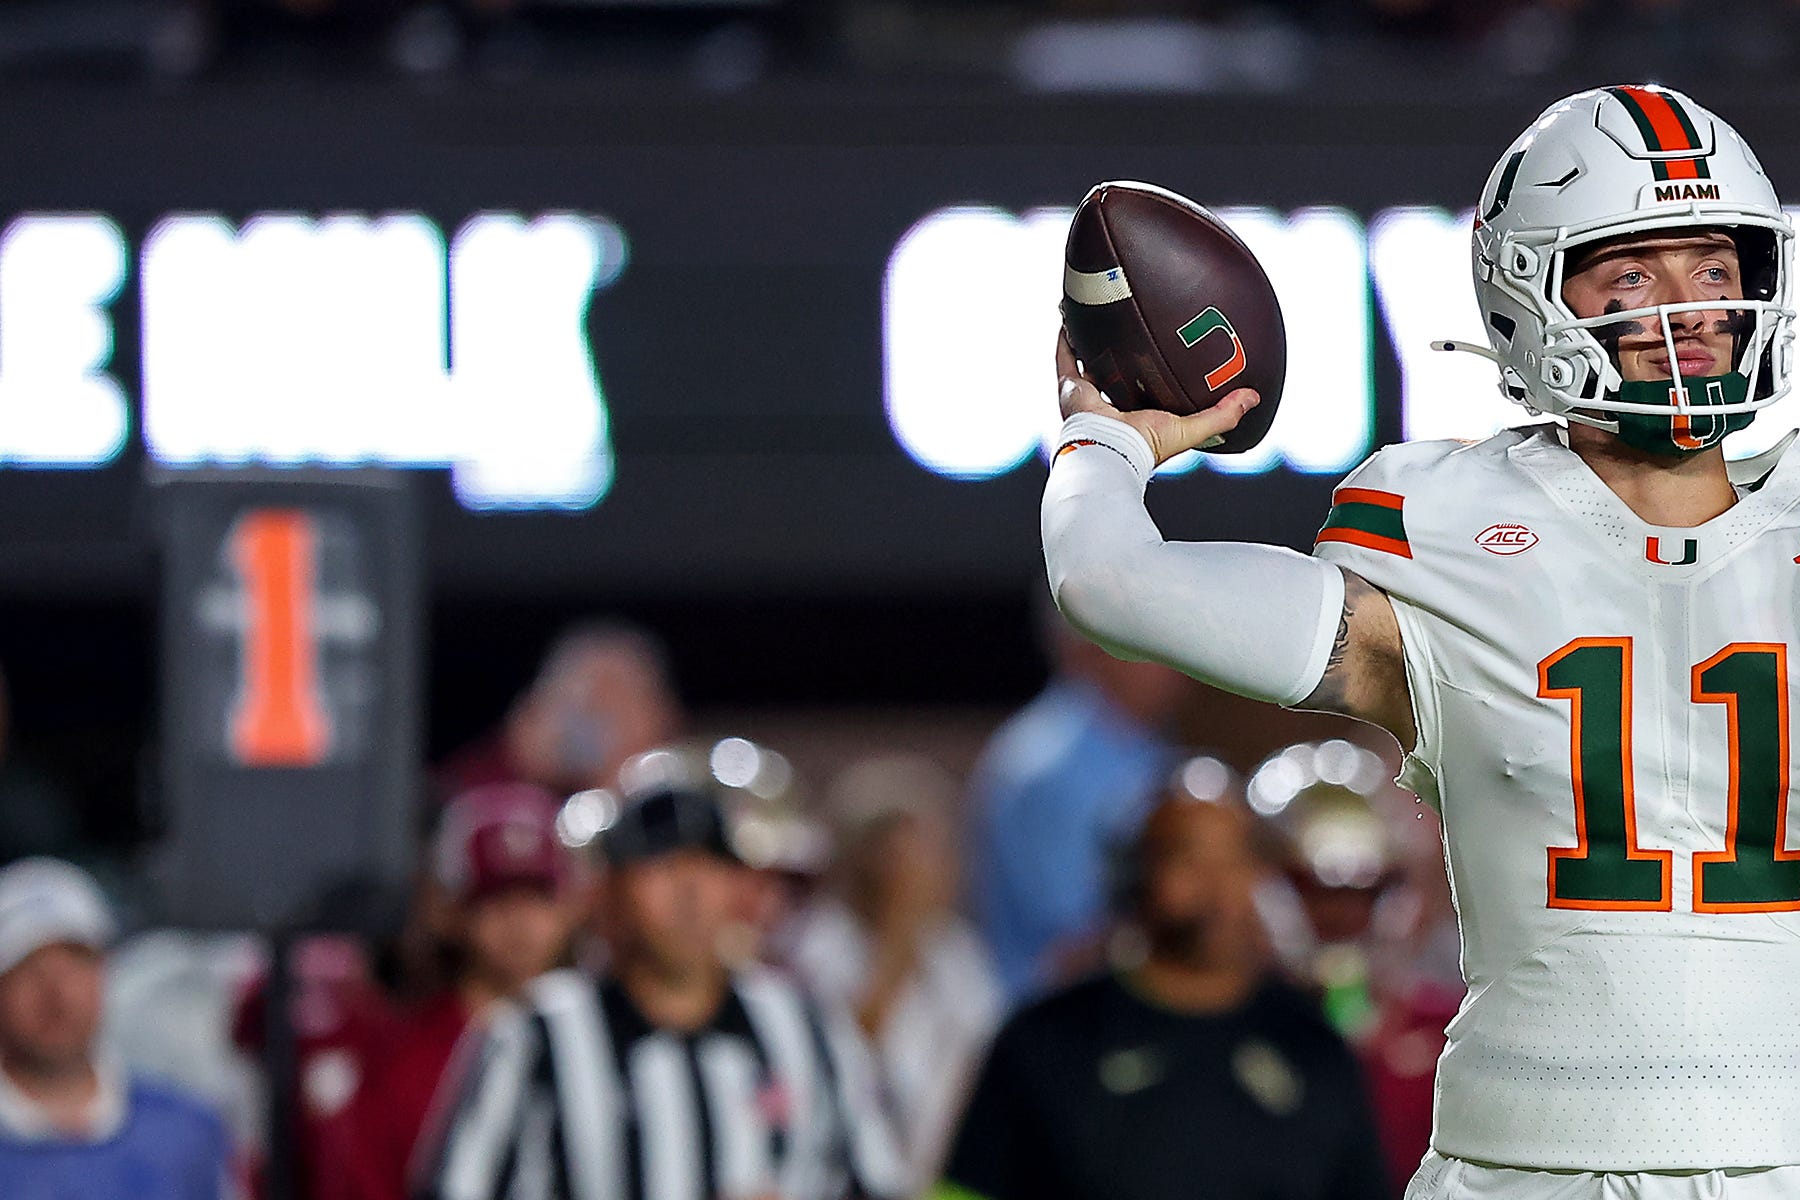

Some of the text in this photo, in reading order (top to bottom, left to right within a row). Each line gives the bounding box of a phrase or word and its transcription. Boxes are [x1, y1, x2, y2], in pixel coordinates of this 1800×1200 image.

[1654, 184, 1720, 202] MIAMI
[1668, 381, 1727, 450] U
[1484, 531, 1530, 543] ACC
[1645, 535, 1698, 566] U
[228, 508, 330, 768] 1
